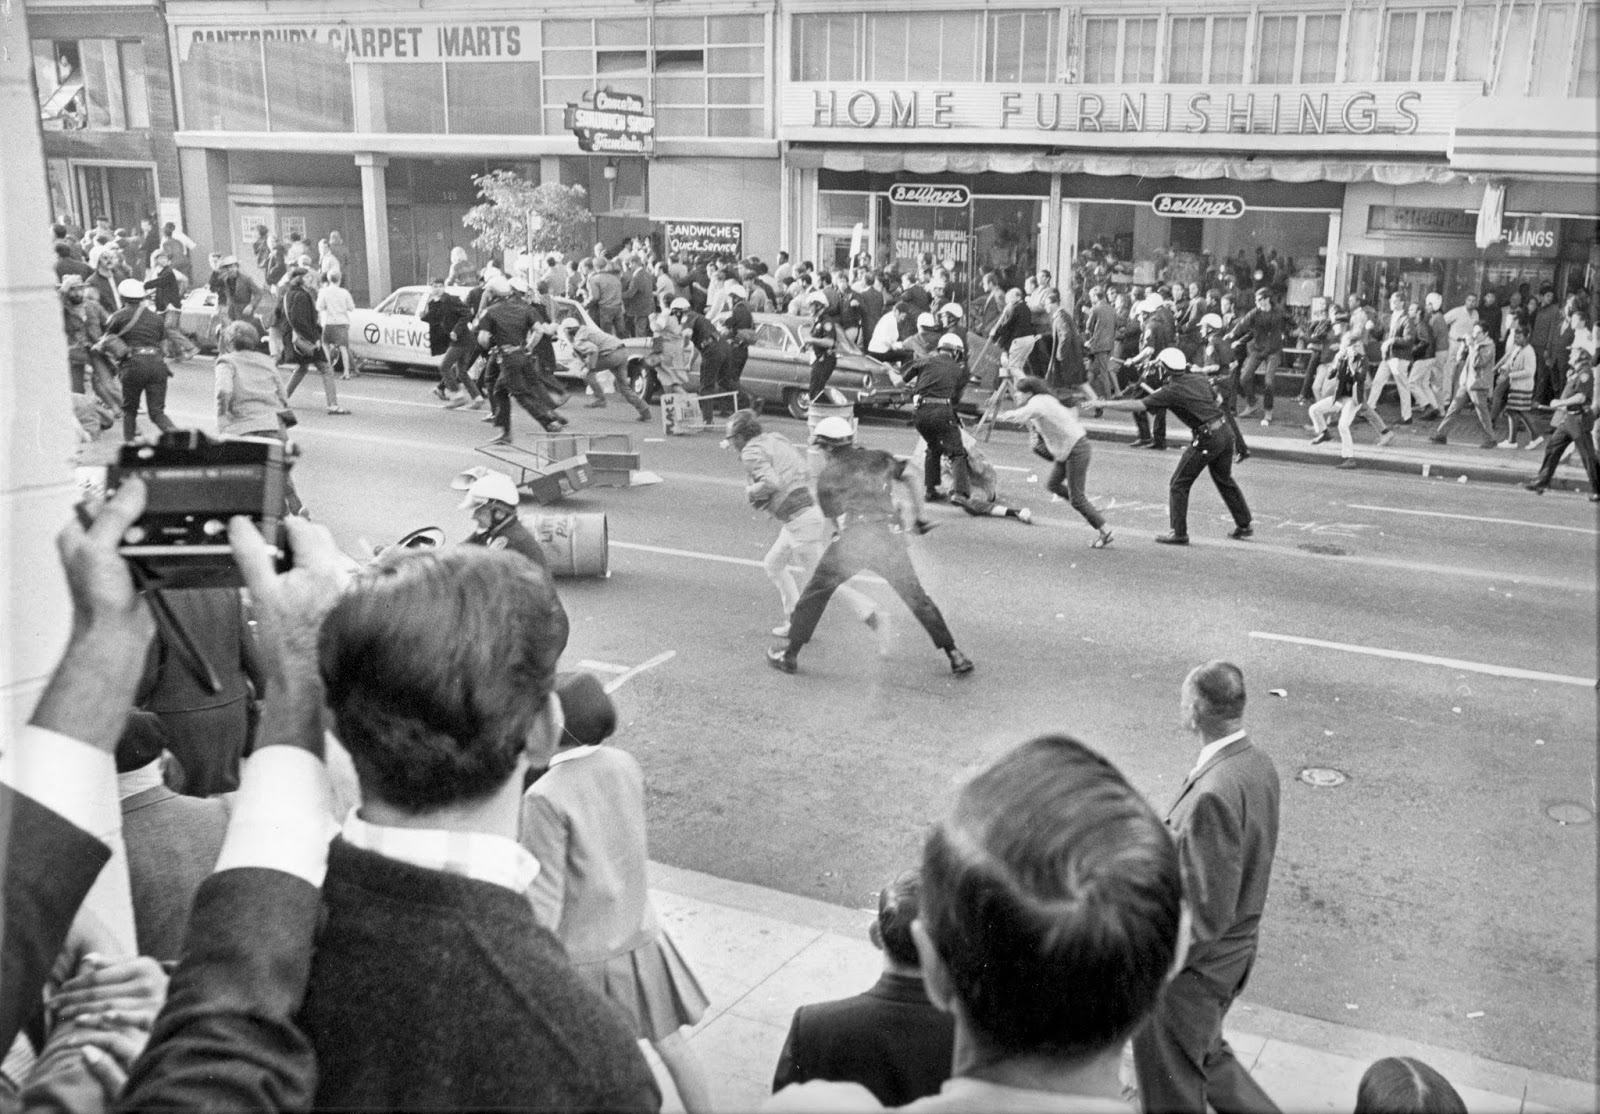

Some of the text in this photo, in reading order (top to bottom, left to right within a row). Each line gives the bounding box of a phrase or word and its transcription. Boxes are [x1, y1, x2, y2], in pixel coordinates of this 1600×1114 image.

[437, 26, 521, 56] MARTS
[812, 90, 1422, 134] HOME FURNISHINGS
[894, 187, 963, 205] Bellings
[1158, 197, 1237, 216] Bellings
[667, 224, 740, 238] SANDWICHES
[671, 239, 737, 254] Quick Service
[895, 240, 920, 259] SOFA
[937, 242, 968, 262] CHAIR
[384, 328, 432, 348] NEWS
